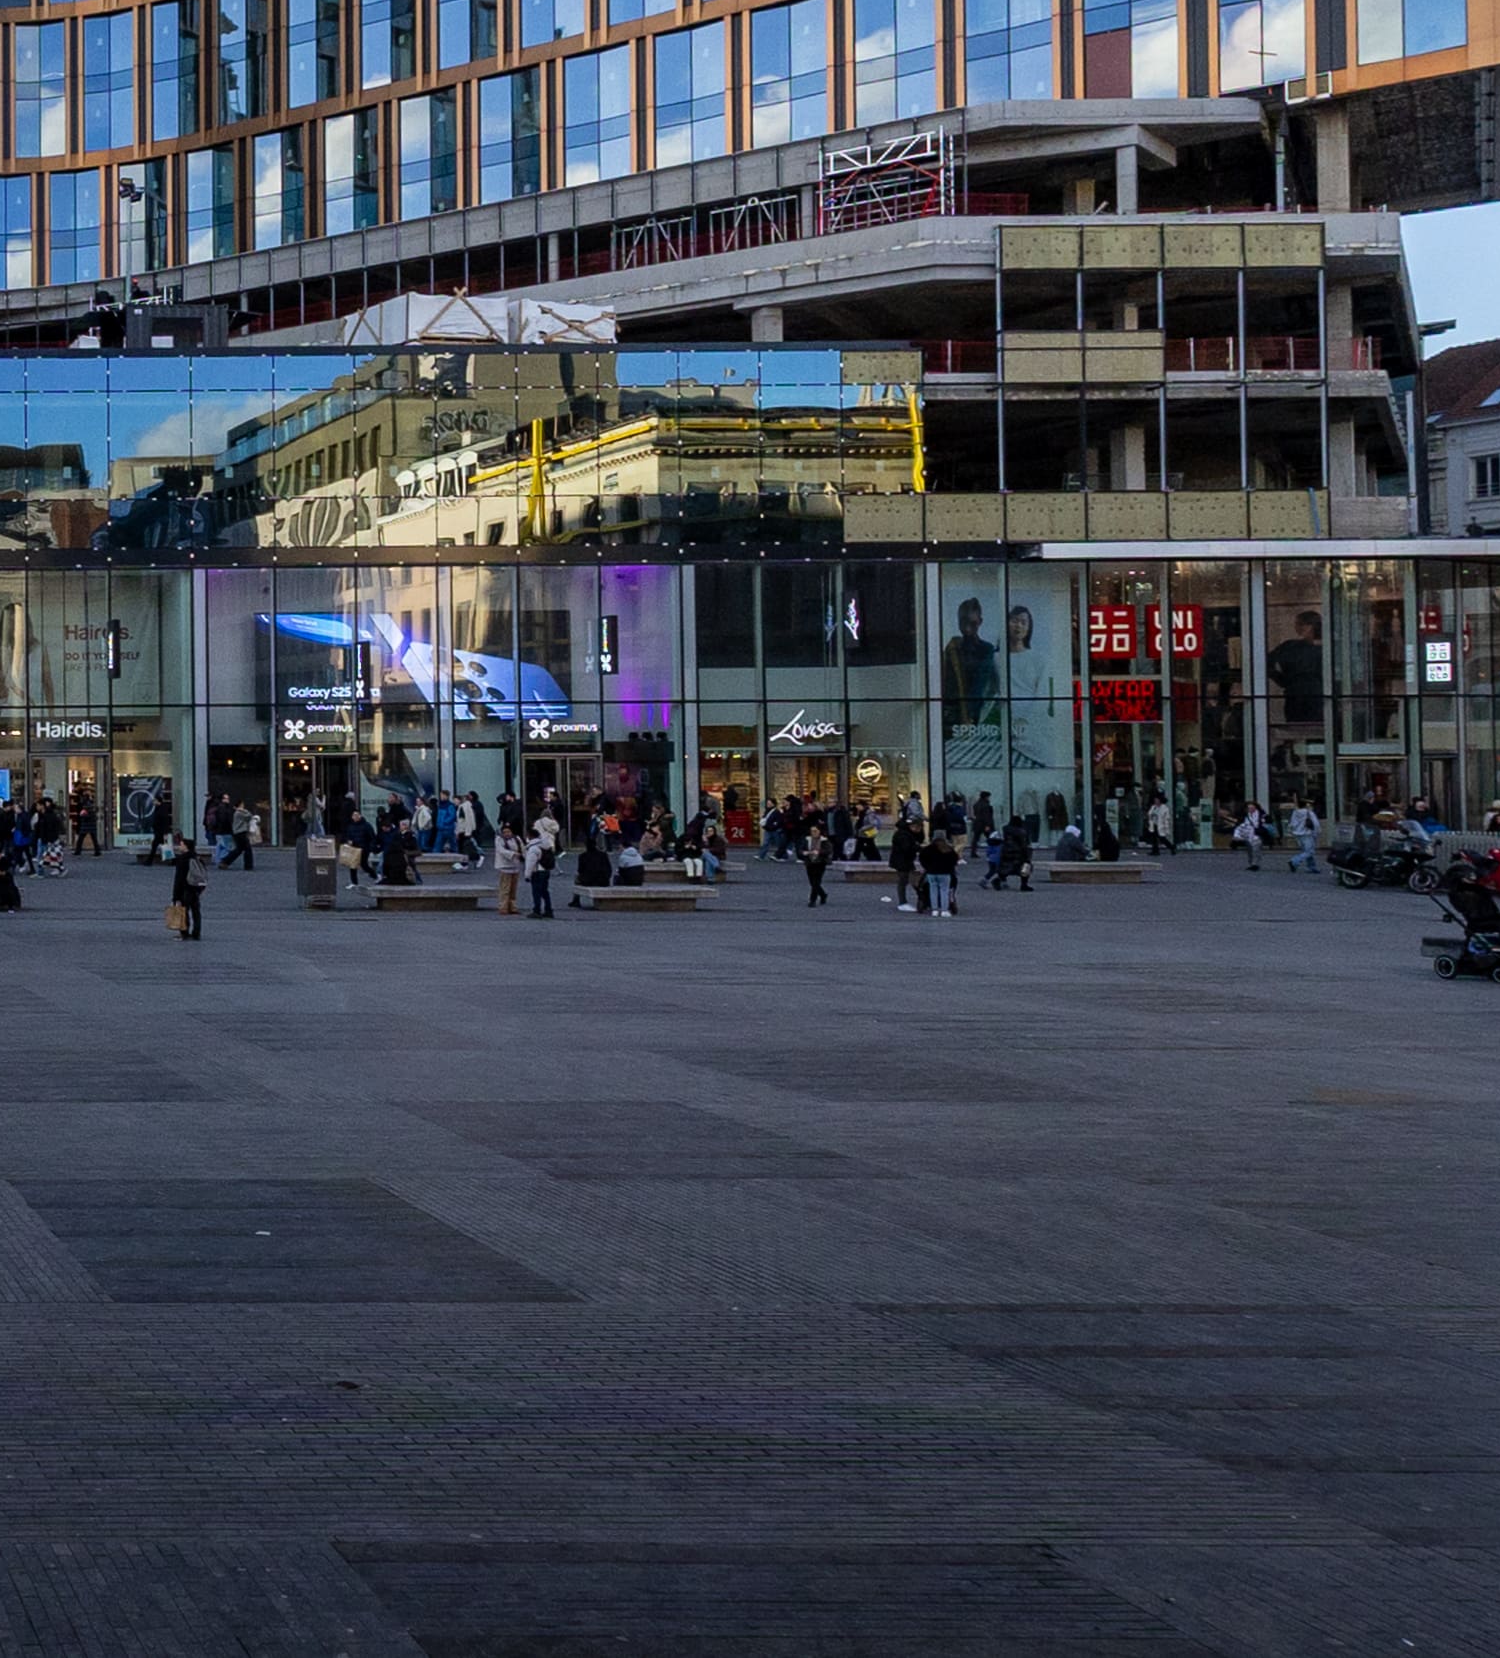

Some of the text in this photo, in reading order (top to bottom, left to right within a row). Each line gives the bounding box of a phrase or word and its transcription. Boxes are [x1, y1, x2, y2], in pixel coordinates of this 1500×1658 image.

[288, 688, 352, 699] Galaxy S25
[769, 709, 844, 746] Lovisa
